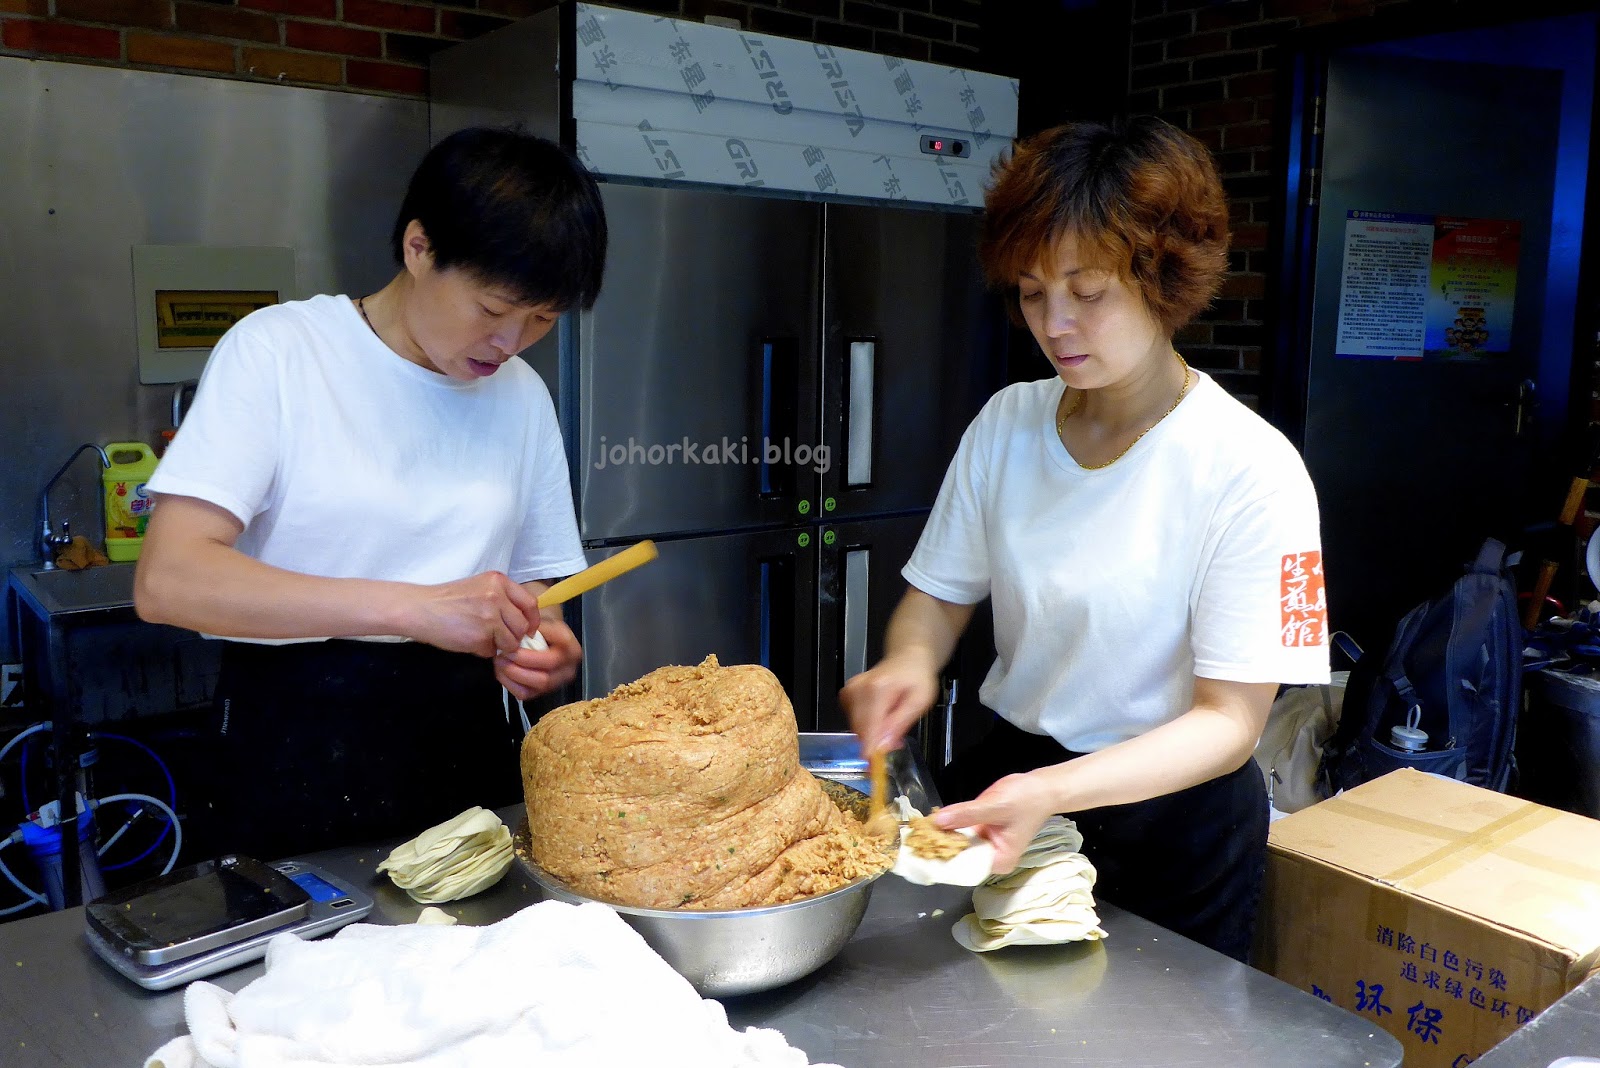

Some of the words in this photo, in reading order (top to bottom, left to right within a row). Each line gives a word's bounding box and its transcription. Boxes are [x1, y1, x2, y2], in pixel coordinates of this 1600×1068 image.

[1376, 924, 1507, 992] 消除白色污染
[1400, 960, 1536, 1025] 追求绿色环保
